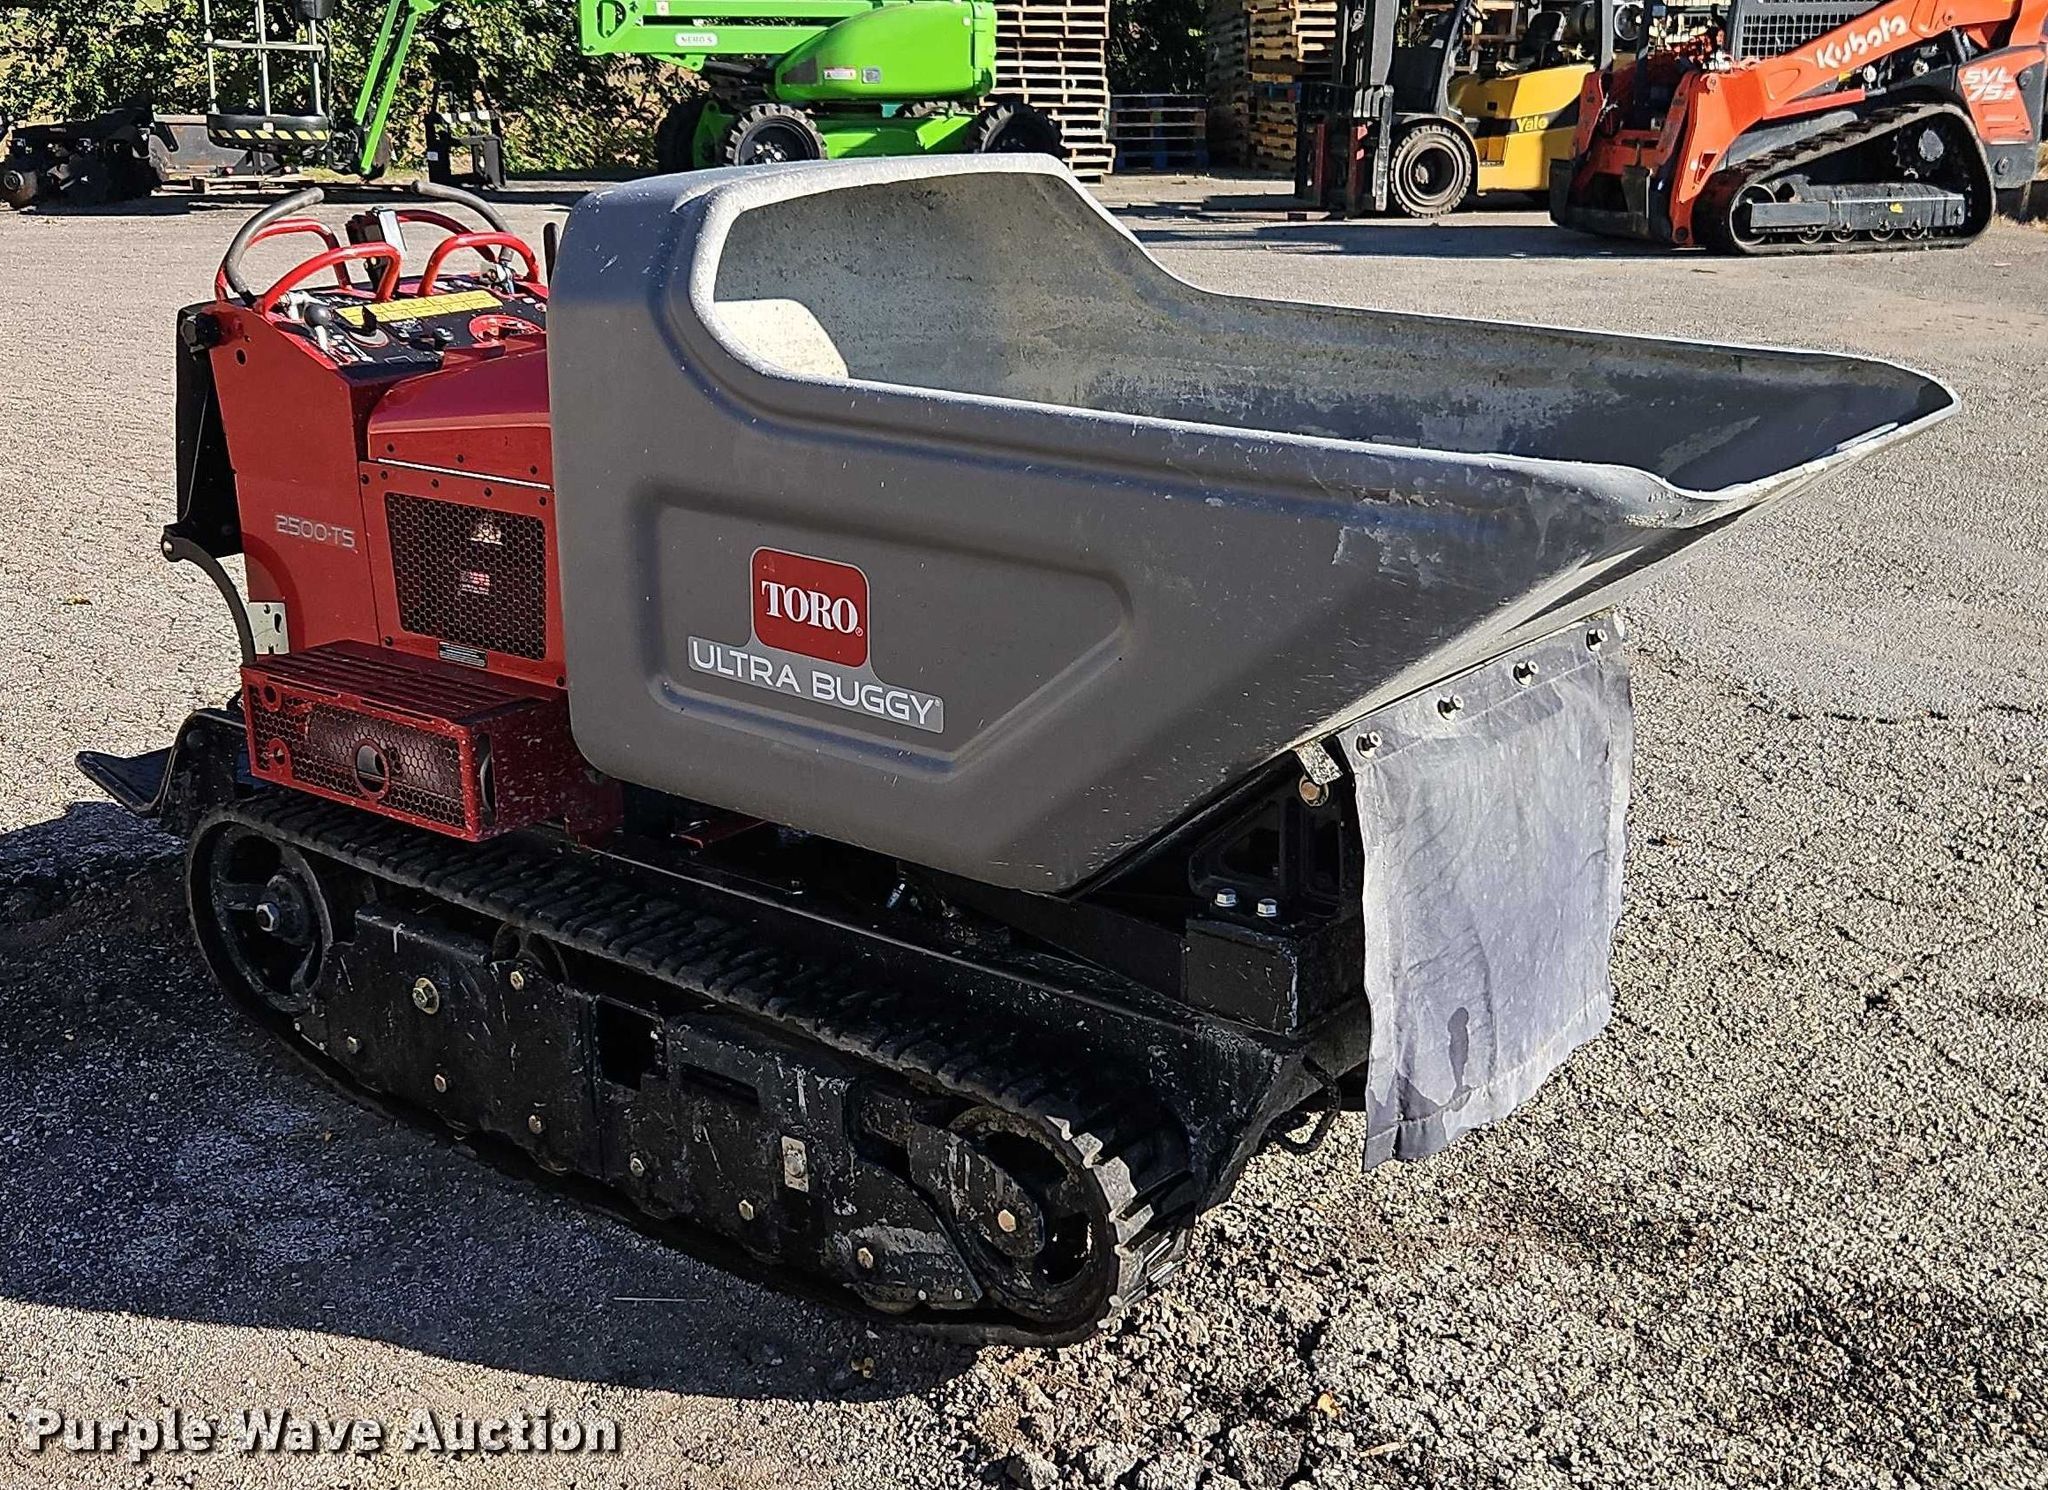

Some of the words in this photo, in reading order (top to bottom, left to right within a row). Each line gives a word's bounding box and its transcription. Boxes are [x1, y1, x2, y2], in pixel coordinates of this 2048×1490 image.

[1816, 15, 1907, 69] Kubota
[1964, 67, 2014, 85] SVL
[1516, 115, 1549, 132] Yale
[761, 580, 859, 634] TORO
[692, 641, 801, 693] ULTRA
[812, 671, 934, 725] BUGGY
